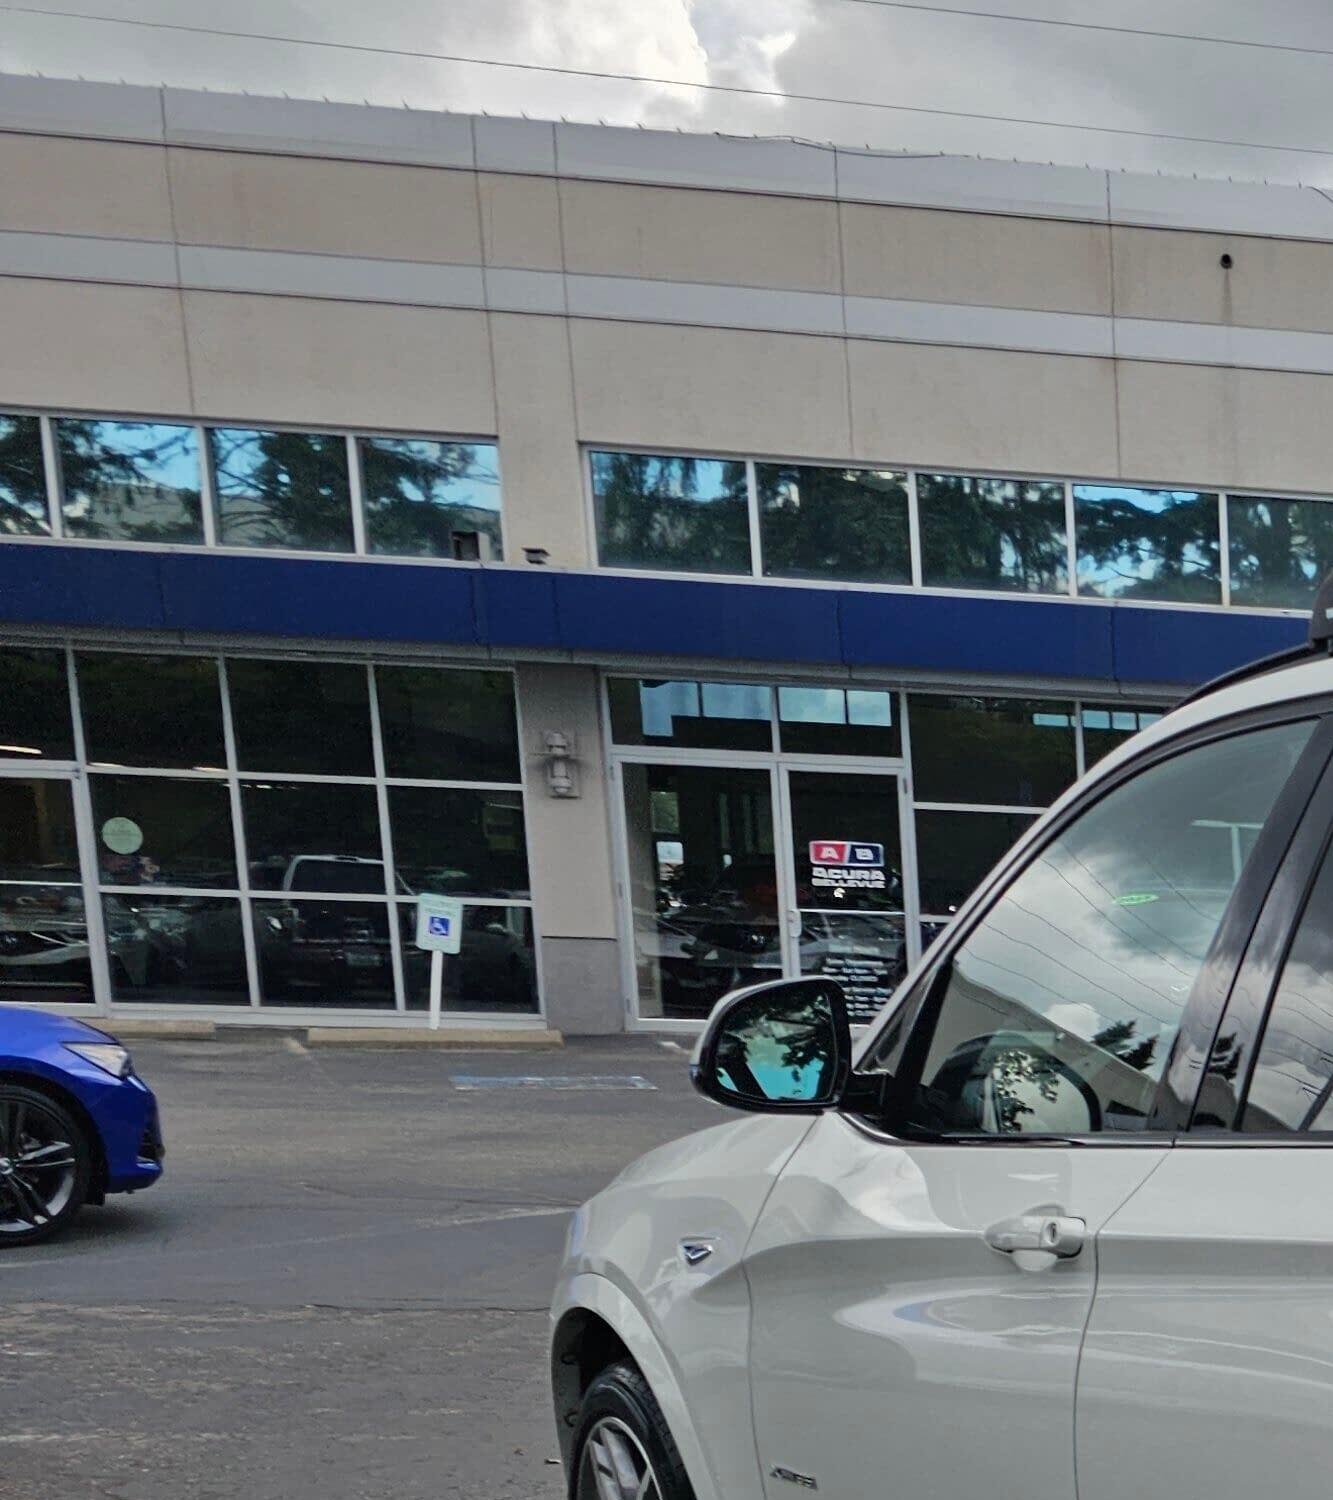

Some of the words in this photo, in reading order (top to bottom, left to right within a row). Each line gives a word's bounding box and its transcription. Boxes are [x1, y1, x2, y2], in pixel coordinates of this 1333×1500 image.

[820, 847, 840, 860] A
[855, 848, 874, 860] B
[812, 867, 886, 880] ACURA
